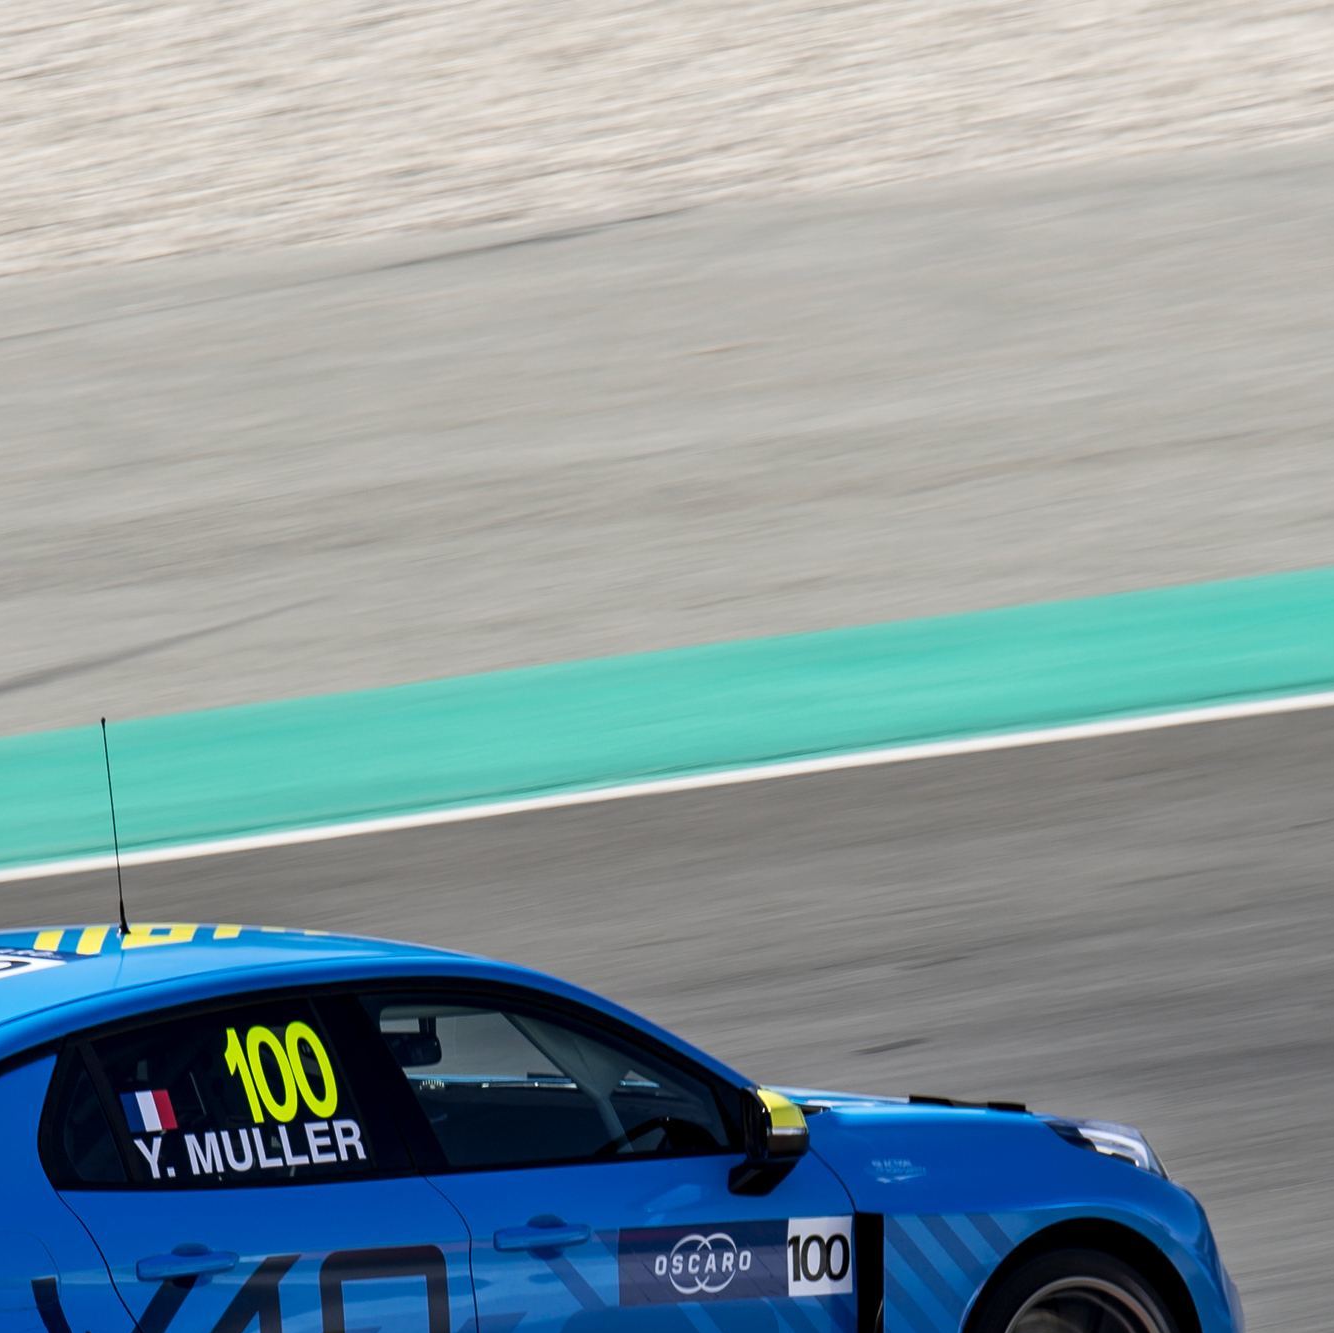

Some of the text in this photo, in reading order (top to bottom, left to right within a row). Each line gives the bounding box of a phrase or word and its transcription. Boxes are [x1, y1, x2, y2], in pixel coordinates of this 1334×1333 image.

[224, 1021, 338, 1124] 100
[134, 1119, 367, 1179] Y. MULLER
[654, 1250, 752, 1277] OSCARO
[787, 1234, 850, 1282] 100
